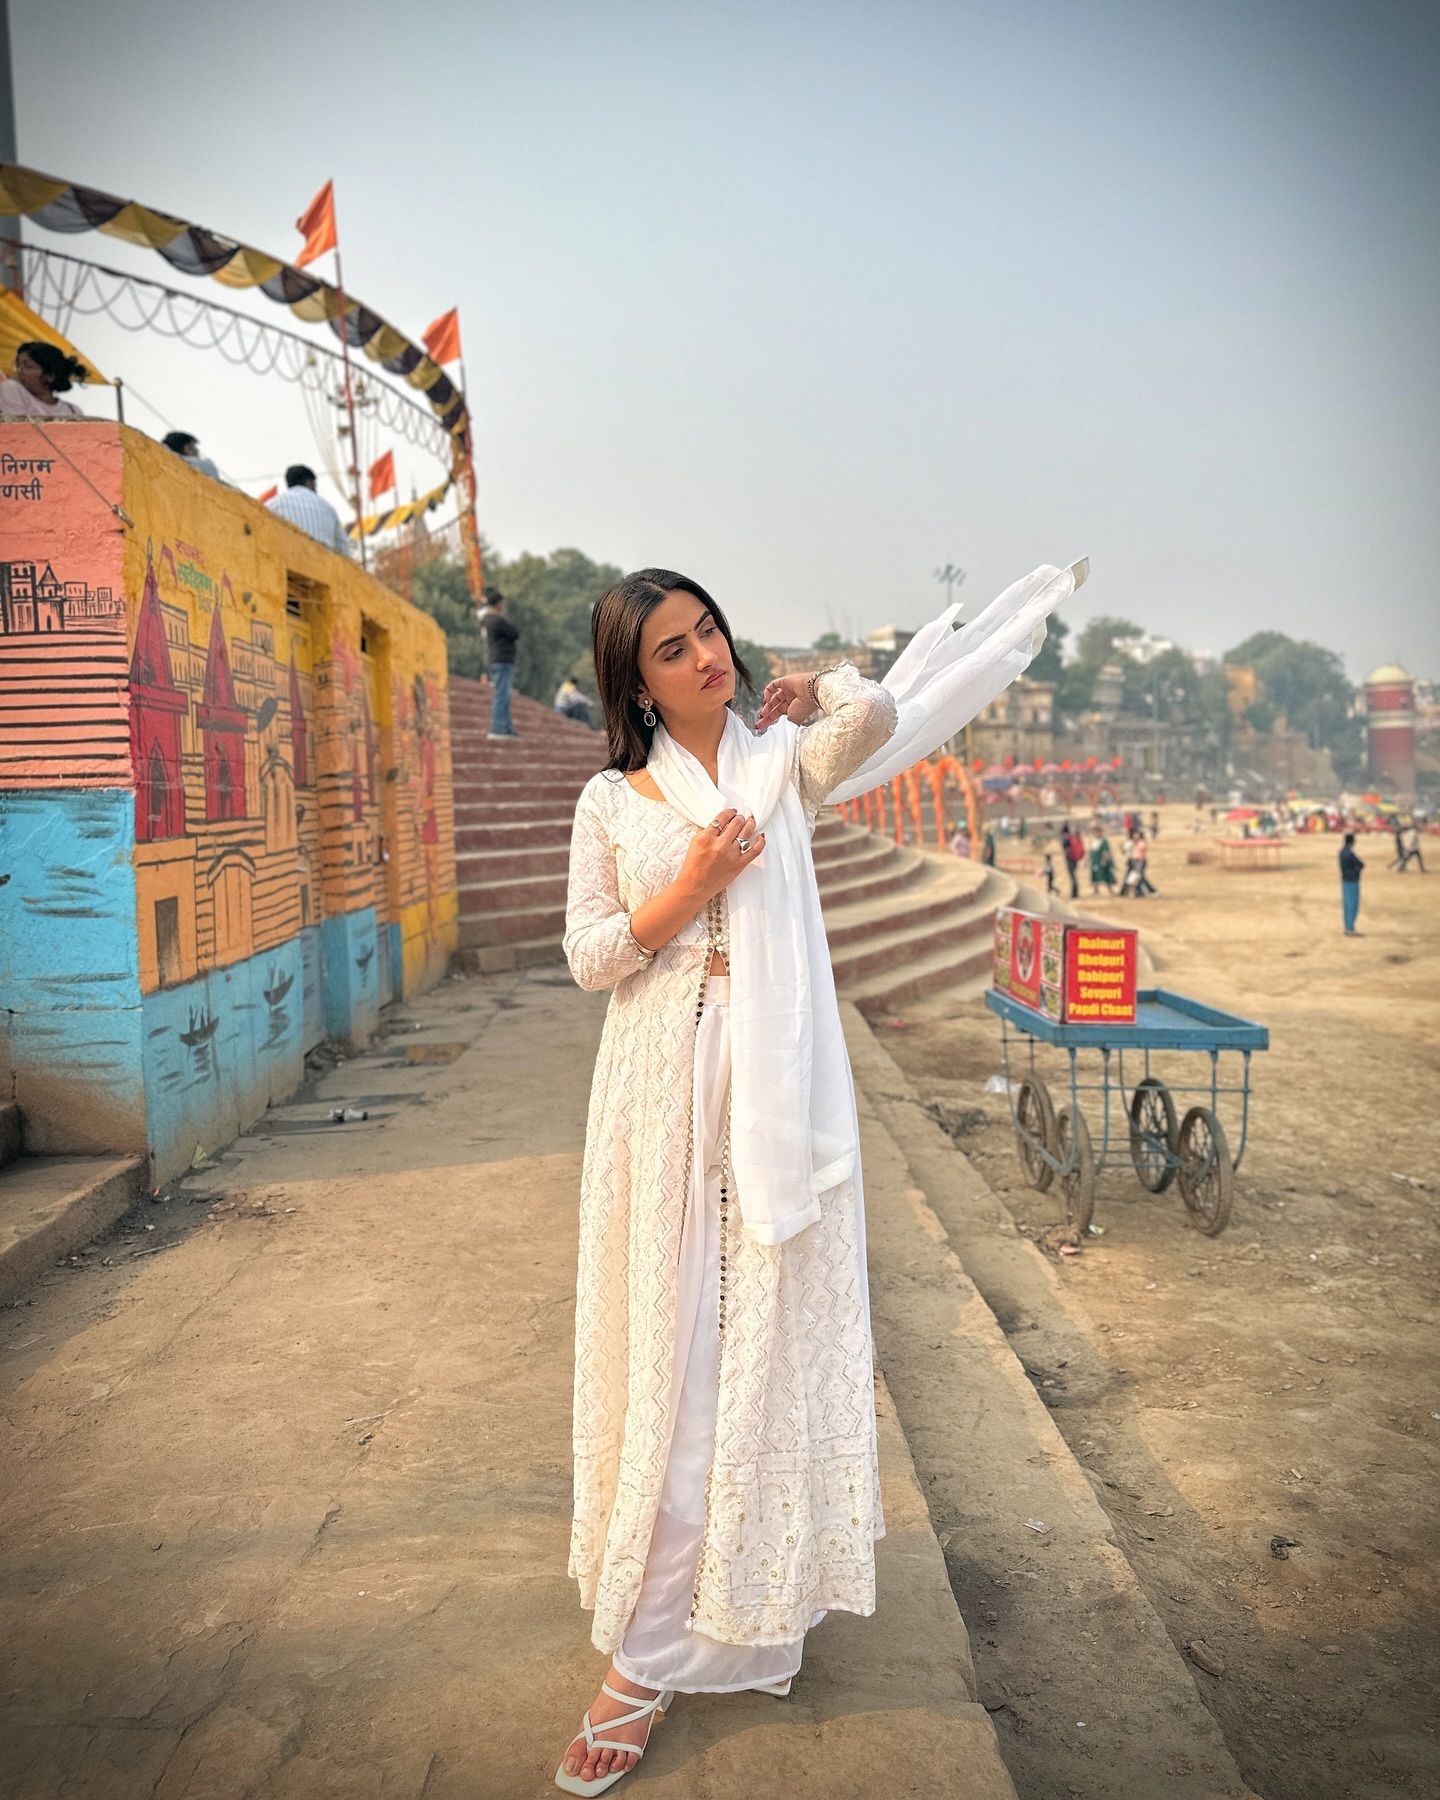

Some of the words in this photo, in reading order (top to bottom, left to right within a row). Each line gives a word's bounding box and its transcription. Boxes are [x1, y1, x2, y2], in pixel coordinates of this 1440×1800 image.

[1, 453, 55, 475] निगम
[0, 477, 43, 501] णसी
[1077, 953, 1125, 967] Bhelpuri
[1077, 970, 1125, 984] Dahipuri
[1079, 986, 1122, 1000] Sevpuri
[1069, 1002, 1099, 1016] Papdi
[1101, 1003, 1133, 1017] Chaat
